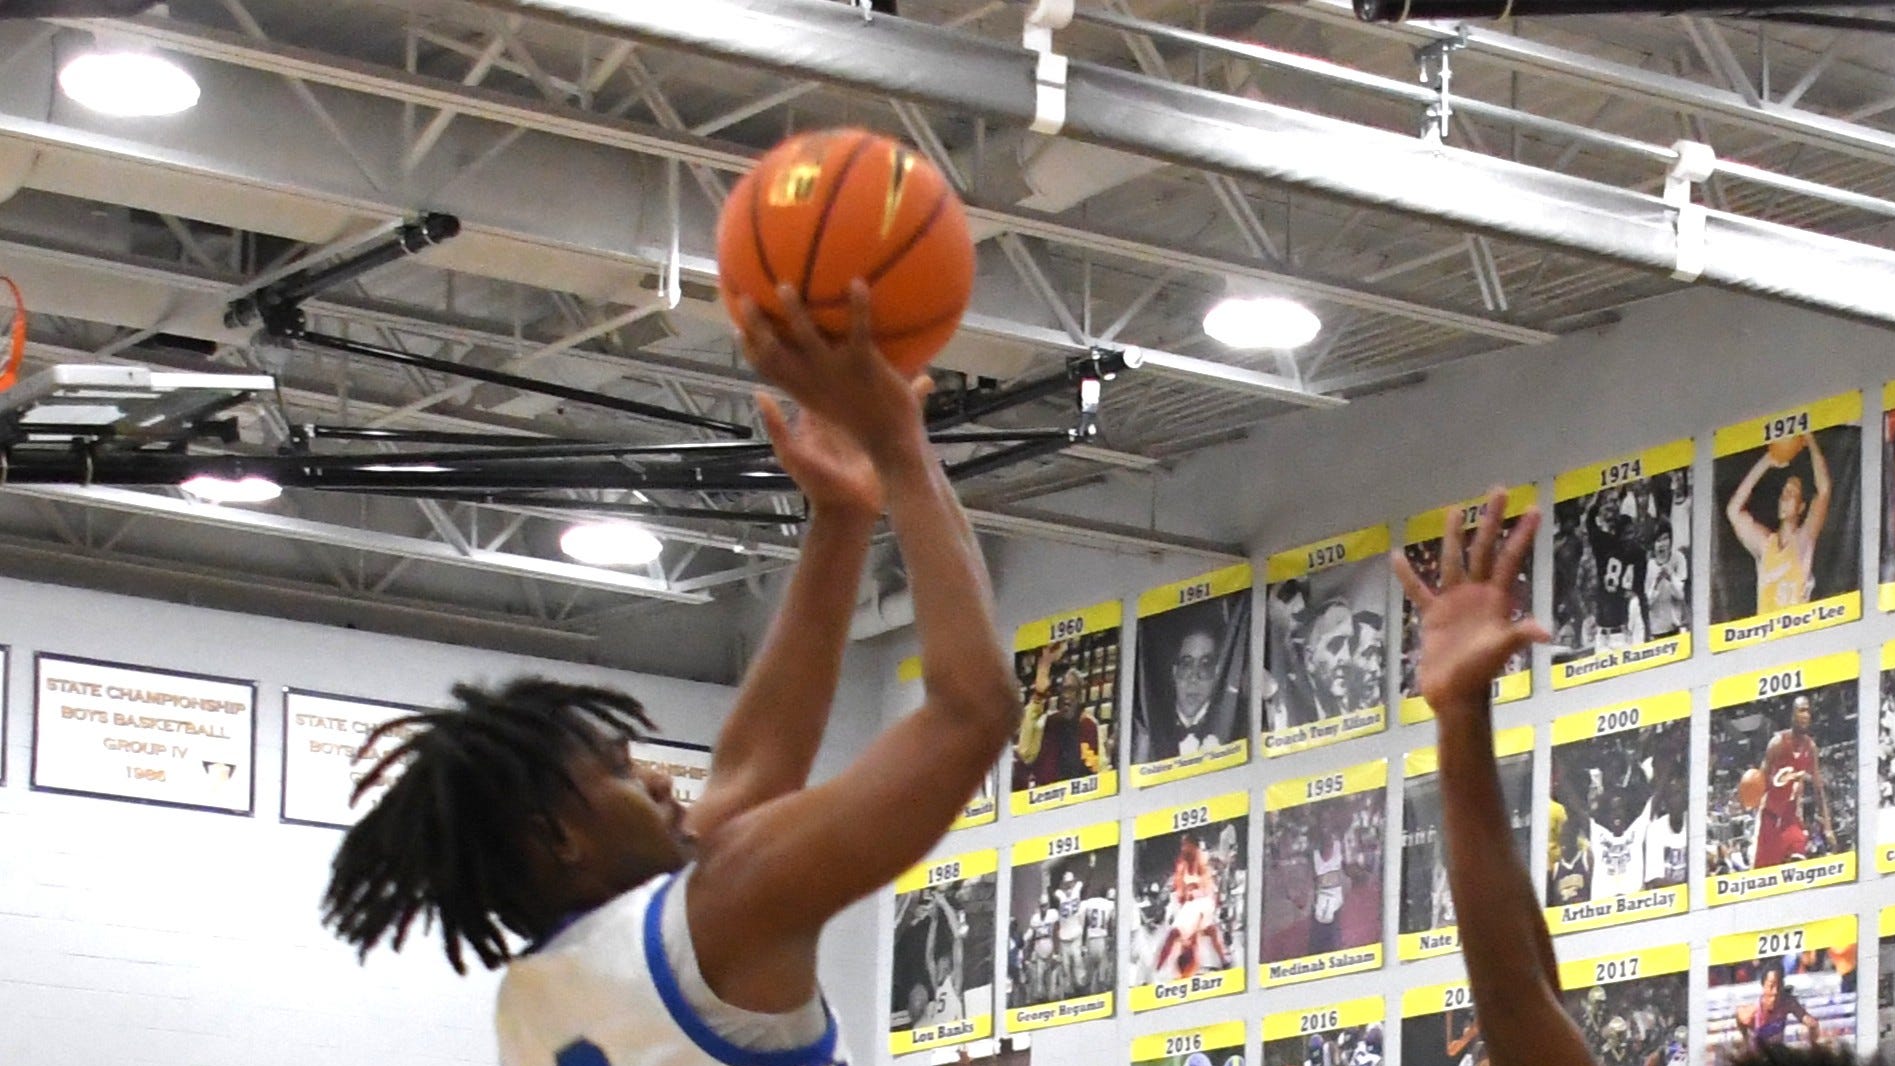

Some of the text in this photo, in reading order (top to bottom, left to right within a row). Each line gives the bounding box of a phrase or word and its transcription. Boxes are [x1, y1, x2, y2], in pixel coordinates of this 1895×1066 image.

[1763, 411, 1808, 442] 1974
[1600, 459, 1641, 486] 1974
[1307, 543, 1345, 570] 1970
[1178, 582, 1212, 604] 1961
[1050, 616, 1084, 638] 1960
[1724, 620, 1775, 643] Darryl
[1819, 604, 1846, 623] Lee
[1564, 640, 1679, 679] Derrick Ramsey
[1758, 669, 1803, 697] 2001
[46, 677, 246, 715] STATE CHAMPIONSHIP
[61, 705, 231, 739] BOYS BASKETBALL
[295, 713, 347, 731] STATE
[1597, 708, 1639, 733] 2000
[103, 737, 167, 756] GROUP
[1265, 728, 1307, 748] Coach
[1028, 776, 1098, 805] Lenny Hall
[1305, 775, 1343, 798] 1995
[1172, 806, 1208, 830] 1992
[1047, 835, 1080, 856] 1991
[927, 862, 961, 885] 1988
[1716, 859, 1844, 897] Dajuan Wagner
[1562, 891, 1675, 923] Arthur Barclay
[1420, 935, 1452, 950] Nate
[1758, 930, 1804, 955] 2017
[1269, 952, 1375, 979] Medinah Salaam
[1596, 958, 1639, 981] 2017
[1155, 977, 1223, 999] Greg Barr
[1445, 987, 1474, 1007] 201
[912, 1021, 974, 1044] Lou Banks
[1301, 1011, 1338, 1032] 2016
[1165, 1034, 1202, 1056] 2016
